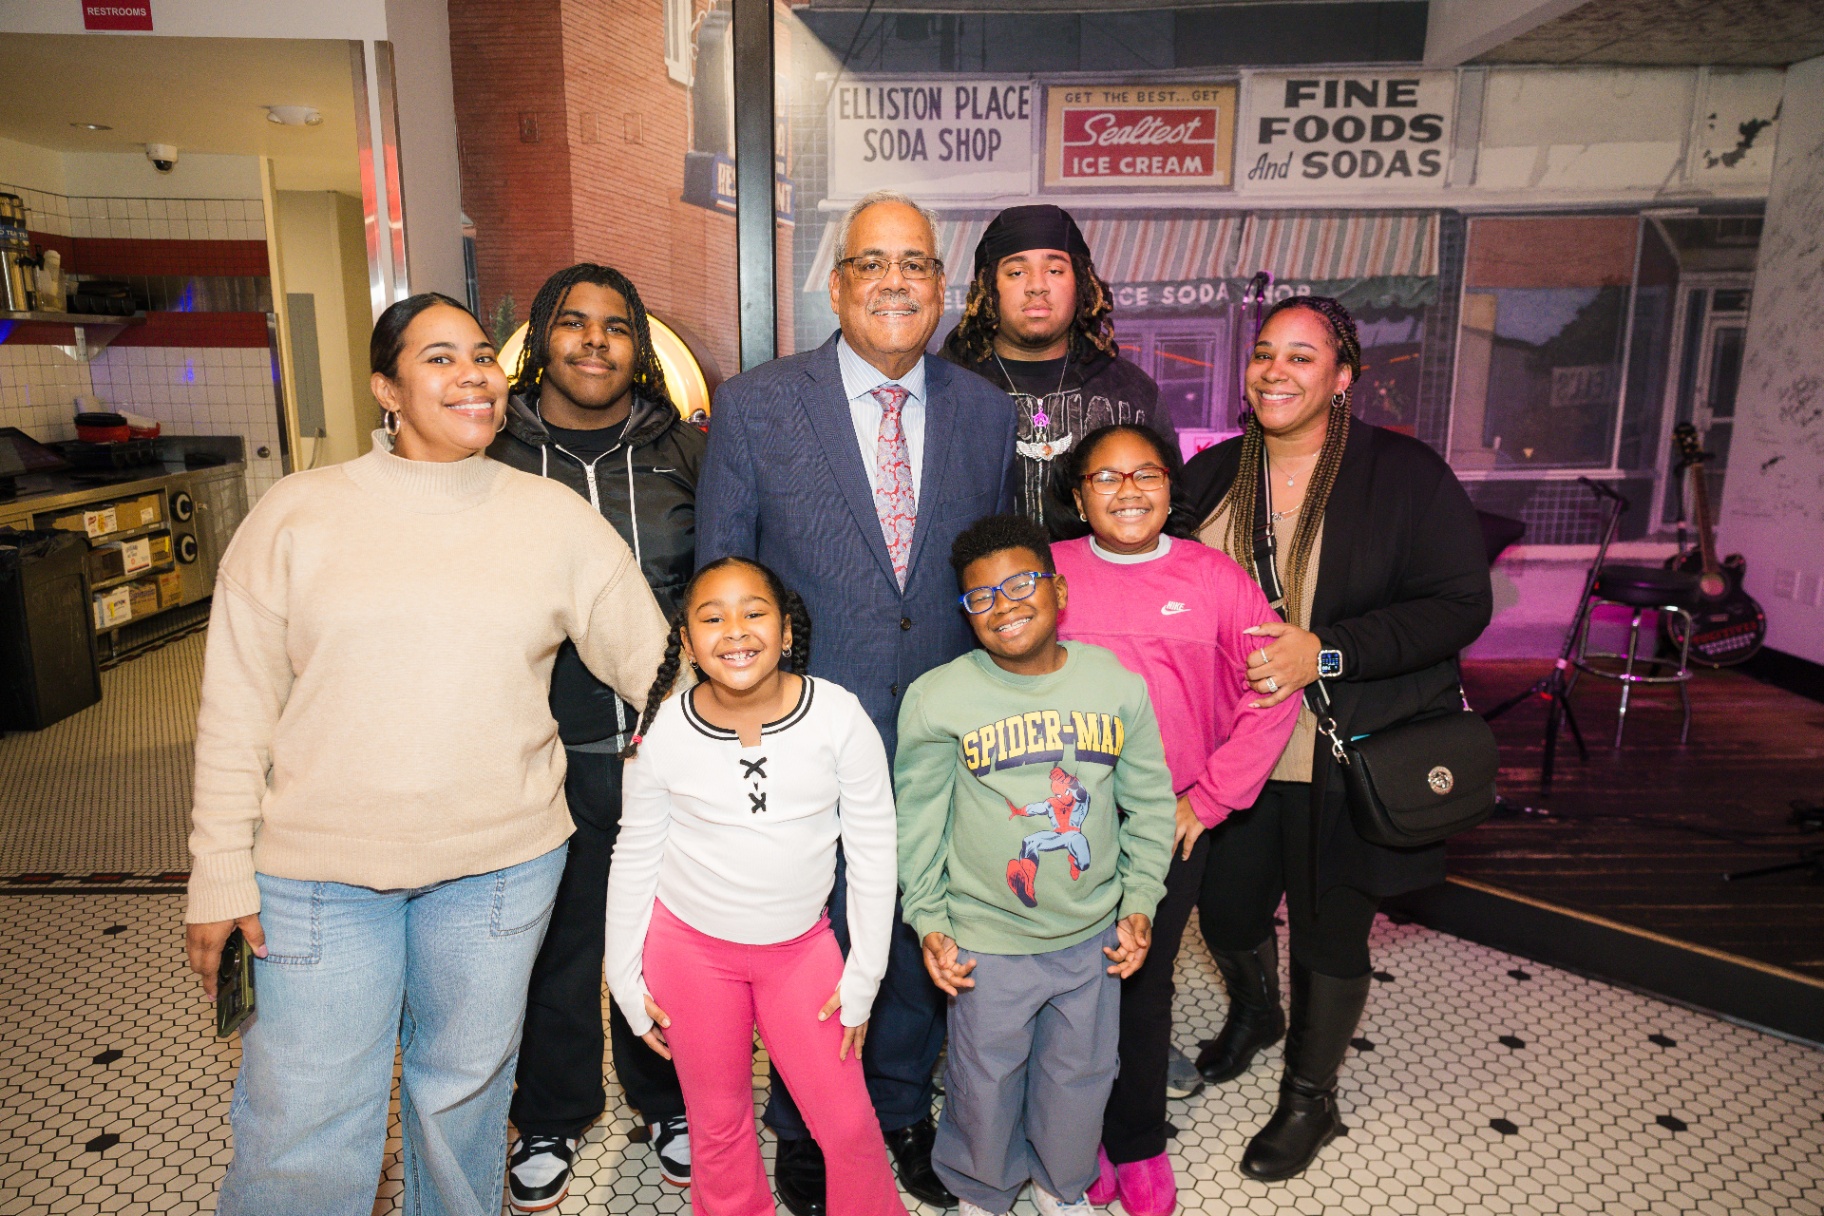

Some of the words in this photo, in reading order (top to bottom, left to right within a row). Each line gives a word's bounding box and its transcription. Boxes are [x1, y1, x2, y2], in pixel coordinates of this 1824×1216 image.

[87, 7, 147, 16] RESTROOMS
[839, 87, 942, 121] ELLISTON
[955, 85, 1030, 120] PLACE
[1065, 92, 1093, 103] GET
[1103, 91, 1129, 103] THE
[1285, 79, 1420, 108] FINE
[1084, 113, 1202, 147] Sealtest
[1258, 113, 1444, 144] FOODS
[863, 127, 928, 162] SODA
[938, 127, 1001, 162] SHOP
[1073, 156, 1111, 174] ICE
[1119, 155, 1203, 174] CREAM
[1248, 151, 1293, 180] And
[1302, 149, 1441, 179] SODAS
[1162, 283, 1230, 305] SODA
[962, 709, 1125, 776] SPIDER-MAN
